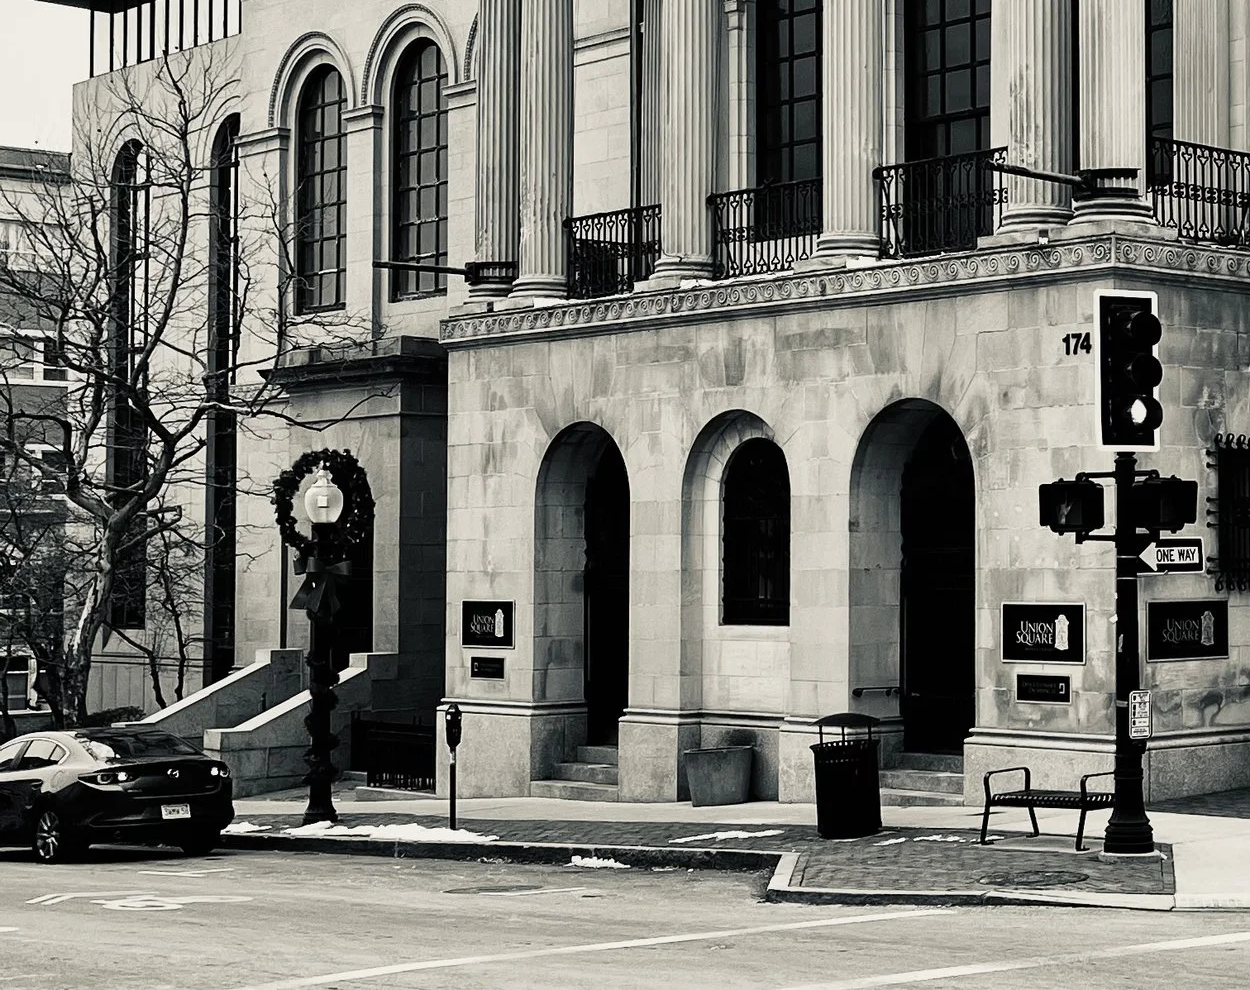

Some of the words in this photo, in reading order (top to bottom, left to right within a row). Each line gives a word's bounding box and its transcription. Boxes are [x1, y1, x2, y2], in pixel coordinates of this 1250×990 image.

[1061, 331, 1093, 356] 174
[1156, 548, 1175, 562] ONE
[1177, 548, 1196, 562] WAY
[1020, 620, 1054, 634] UNION
[1166, 618, 1200, 631] UNION
[1016, 630, 1054, 646] SQUARE
[1162, 628, 1199, 644] SQUARE
